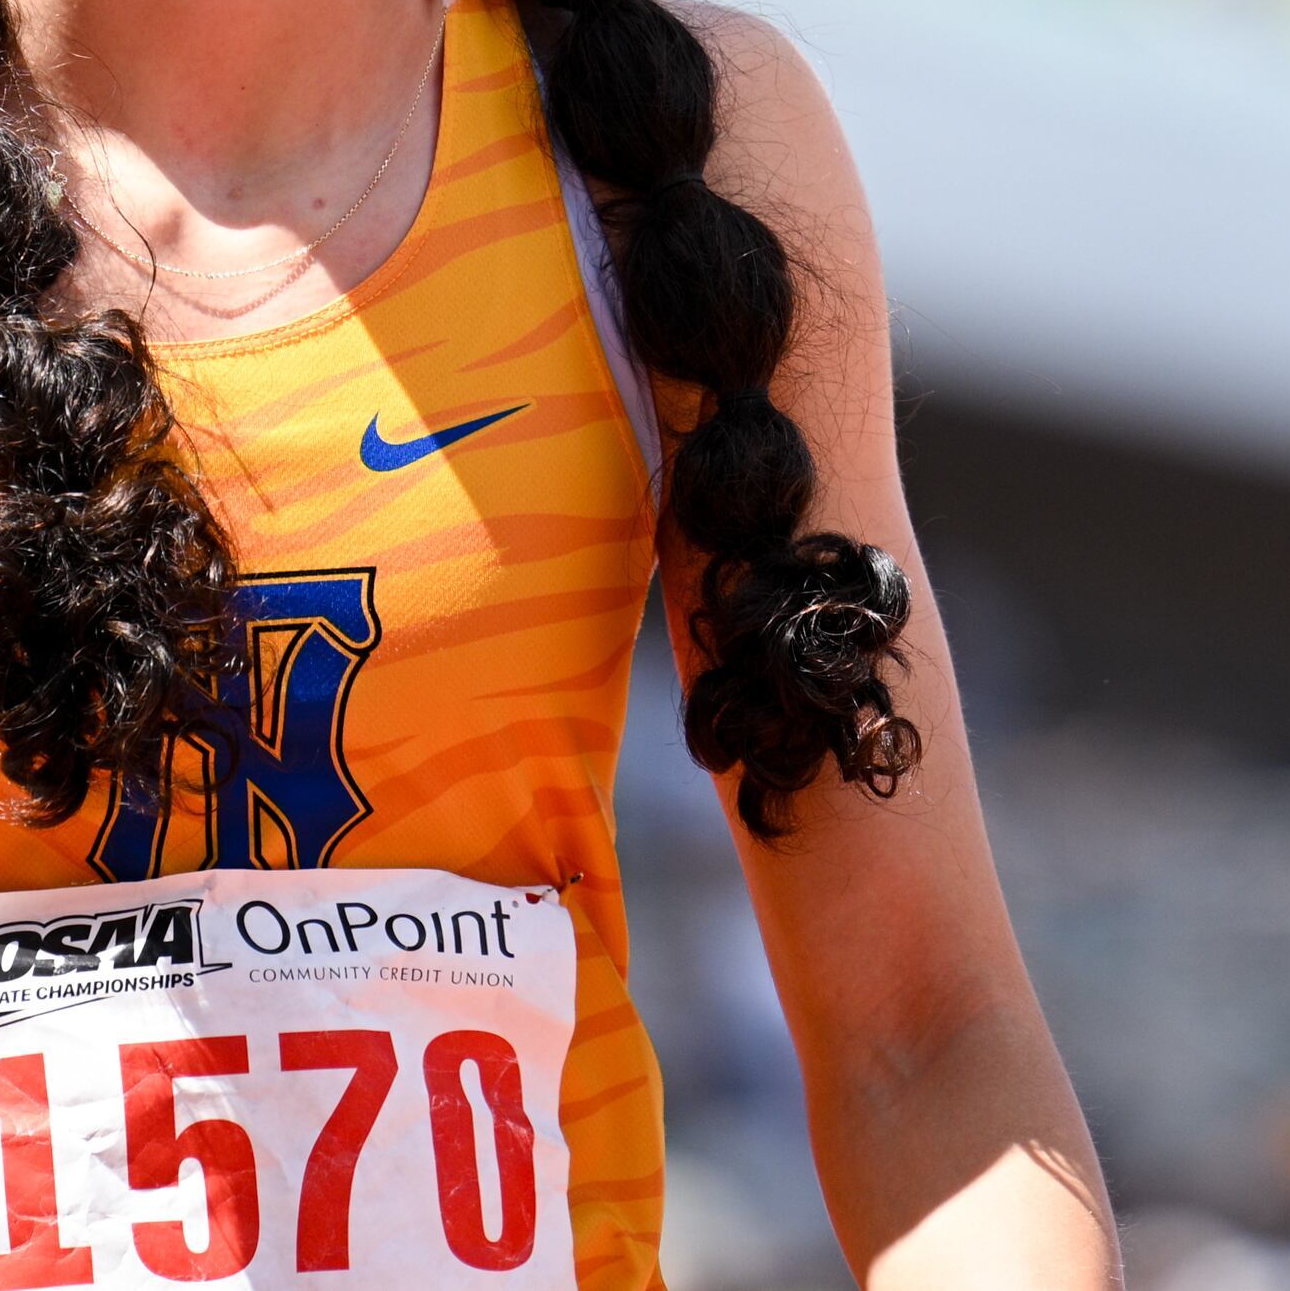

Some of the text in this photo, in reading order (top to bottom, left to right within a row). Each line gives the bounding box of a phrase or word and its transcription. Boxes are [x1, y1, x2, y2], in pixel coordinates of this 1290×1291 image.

[236, 900, 515, 959] OnPoint
[35, 972, 195, 1001] CHAMPIONSHIPS
[249, 966, 515, 987] COMMUNITY CREDIT UNION
